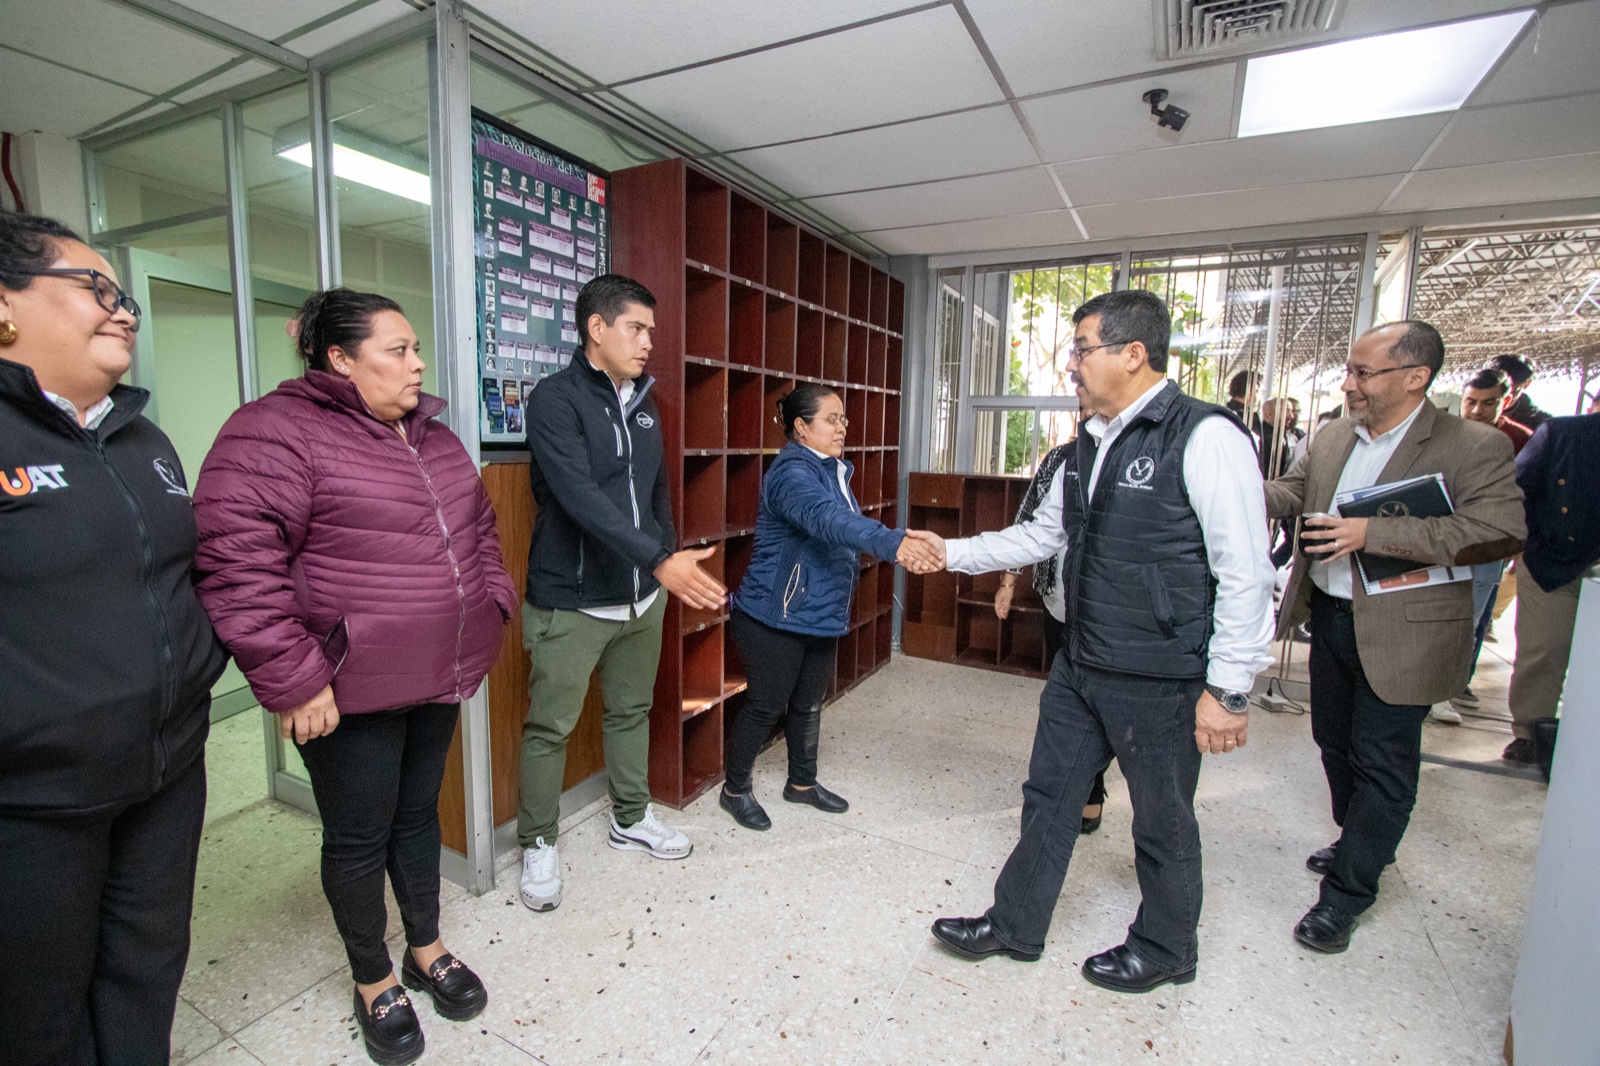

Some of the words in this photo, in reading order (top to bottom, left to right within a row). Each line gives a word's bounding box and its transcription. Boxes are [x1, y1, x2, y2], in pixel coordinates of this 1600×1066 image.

[484, 139, 531, 173] Pensamiento
[534, 162, 582, 194] Administrativo
[502, 133, 553, 167] Evolución
[558, 159, 573, 175] del
[0, 464, 69, 496] UAT
